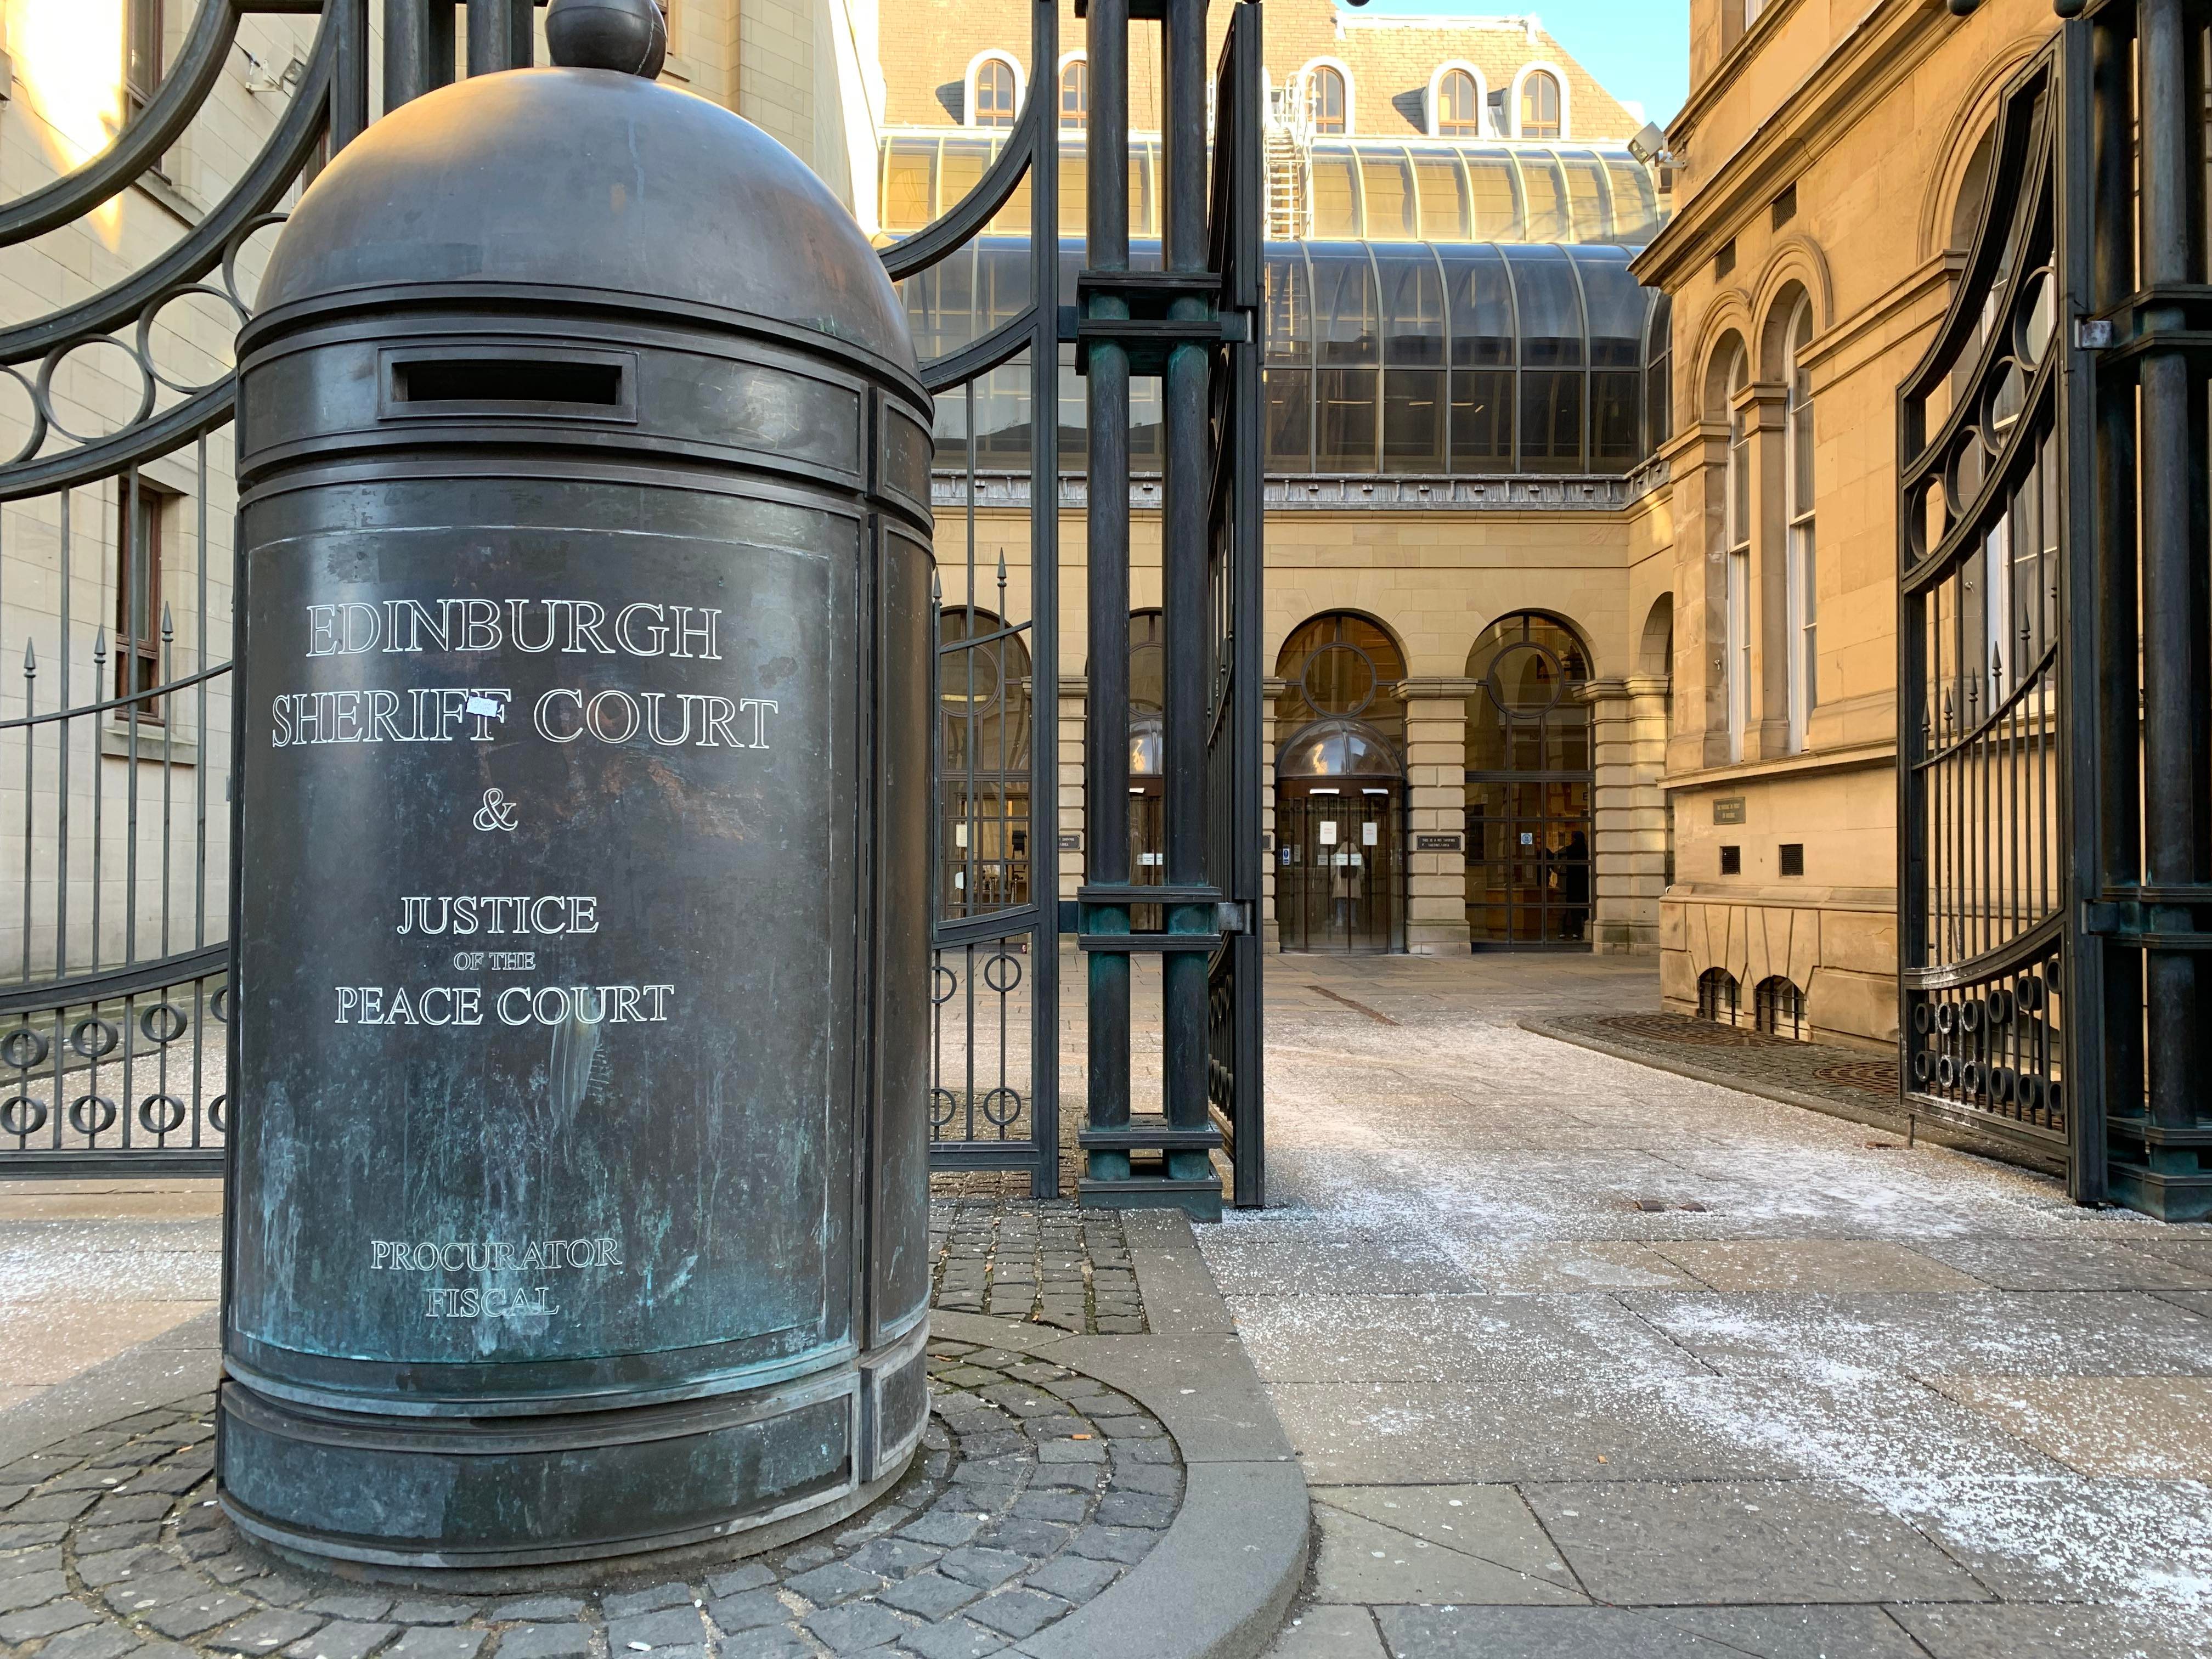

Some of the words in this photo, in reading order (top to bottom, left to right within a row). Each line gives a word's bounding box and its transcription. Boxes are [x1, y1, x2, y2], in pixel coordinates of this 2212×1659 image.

[306, 599, 723, 659] EDINBURGH
[272, 688, 511, 748] SHERIFF
[534, 689, 778, 749] COURT
[473, 787, 518, 832] &
[397, 896, 599, 934] JUSTICE
[453, 952, 484, 970] OF
[489, 952, 536, 970] THE
[335, 986, 484, 1026] PEACE
[496, 984, 675, 1026] COURT
[370, 1238, 623, 1271] PROCURATOR
[425, 1287, 560, 1317] FISCAL
